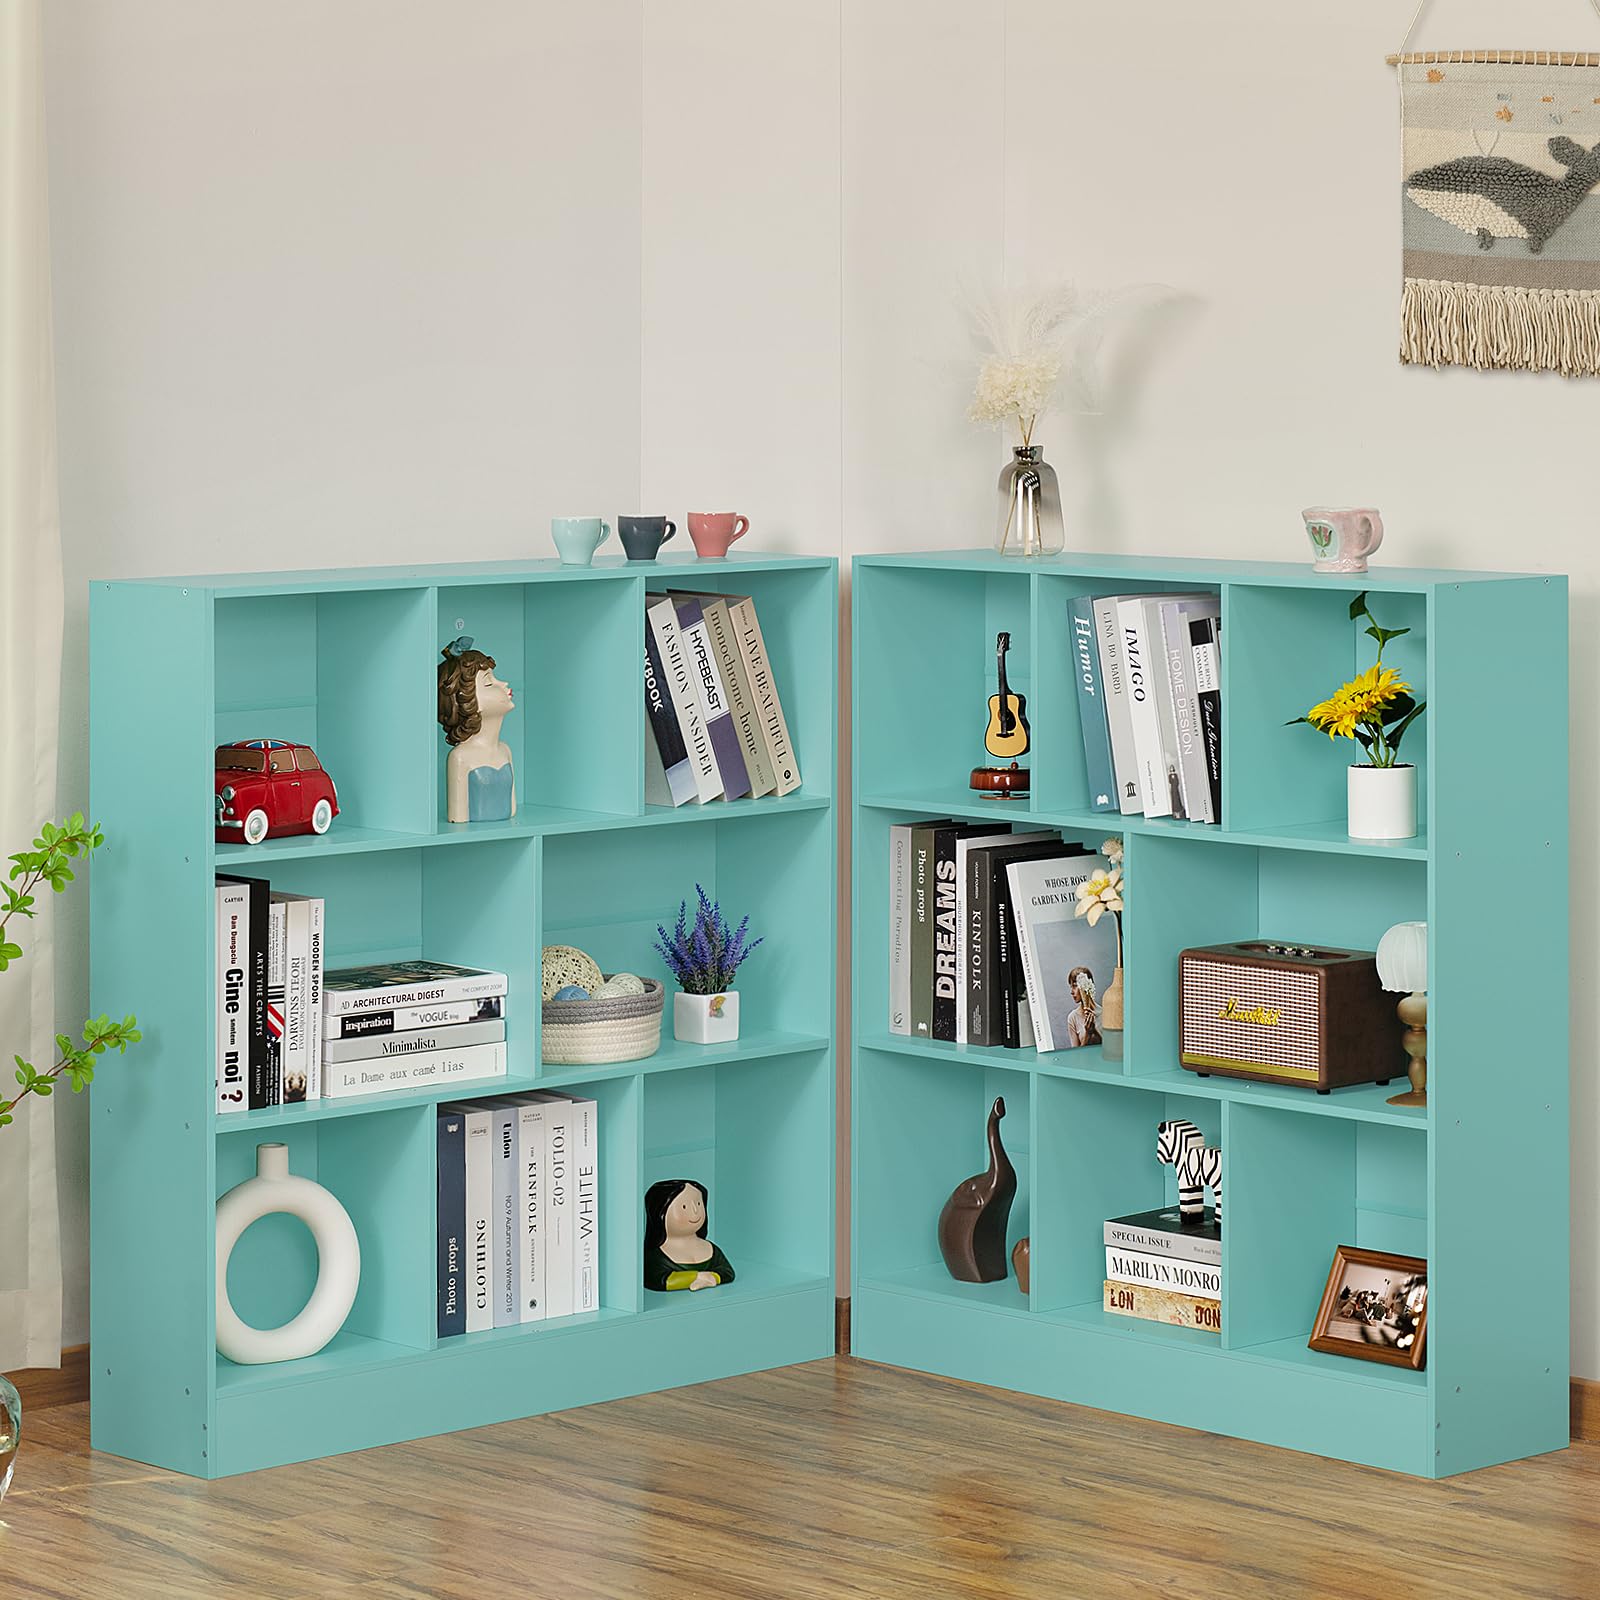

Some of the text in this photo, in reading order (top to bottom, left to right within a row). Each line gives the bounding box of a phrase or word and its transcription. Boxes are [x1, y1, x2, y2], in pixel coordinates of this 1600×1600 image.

[690, 629, 722, 711] HYPEBEAST
[1073, 615, 1095, 696] Humor
[1103, 611, 1122, 695] LINA BO BARDI
[1124, 626, 1146, 702] IMAGO
[1170, 650, 1184, 694] HOME
[662, 622, 713, 776] FASHION INSIDER
[711, 611, 758, 756] monochrome home
[743, 628, 763, 669] LIVE
[755, 671, 788, 764] BEAUTIFUL
[917, 850, 926, 923] Photo props
[1031, 894, 1060, 906] GARDEN
[1060, 893, 1068, 903] IS
[1045, 875, 1087, 888] WHOSE ROSE
[312, 933, 320, 971] WOODEN
[936, 860, 956, 999] DREAMS
[972, 910, 982, 991] KINFOLK
[999, 903, 1008, 962] Remodelista
[225, 968, 244, 1014] Cine
[256, 951, 264, 975] ARTS
[255, 998, 263, 1037] CRAFTS
[289, 957, 300, 1052] DARWINS TEORI
[340, 989, 445, 1010] AD ARCHITECTURAL DIGEST
[345, 1017, 392, 1032] inspiration
[419, 1010, 448, 1023] VOGUE
[224, 1051, 243, 1084] noi
[344, 1060, 464, 1086] La Dame aux camé lias
[382, 1038, 436, 1055] Minimalista
[553, 1126, 564, 1206] FOLIO-02
[528, 1162, 537, 1234] KINFOLK
[579, 1166, 593, 1239] WHITE
[476, 1219, 486, 1309] CLOTHING
[1112, 1231, 1171, 1249] SPECIAL ISSUE
[446, 1237, 459, 1315] Photo props
[1110, 1288, 1134, 1311] LON
[1112, 1257, 1221, 1291] MARILYN MONRO
